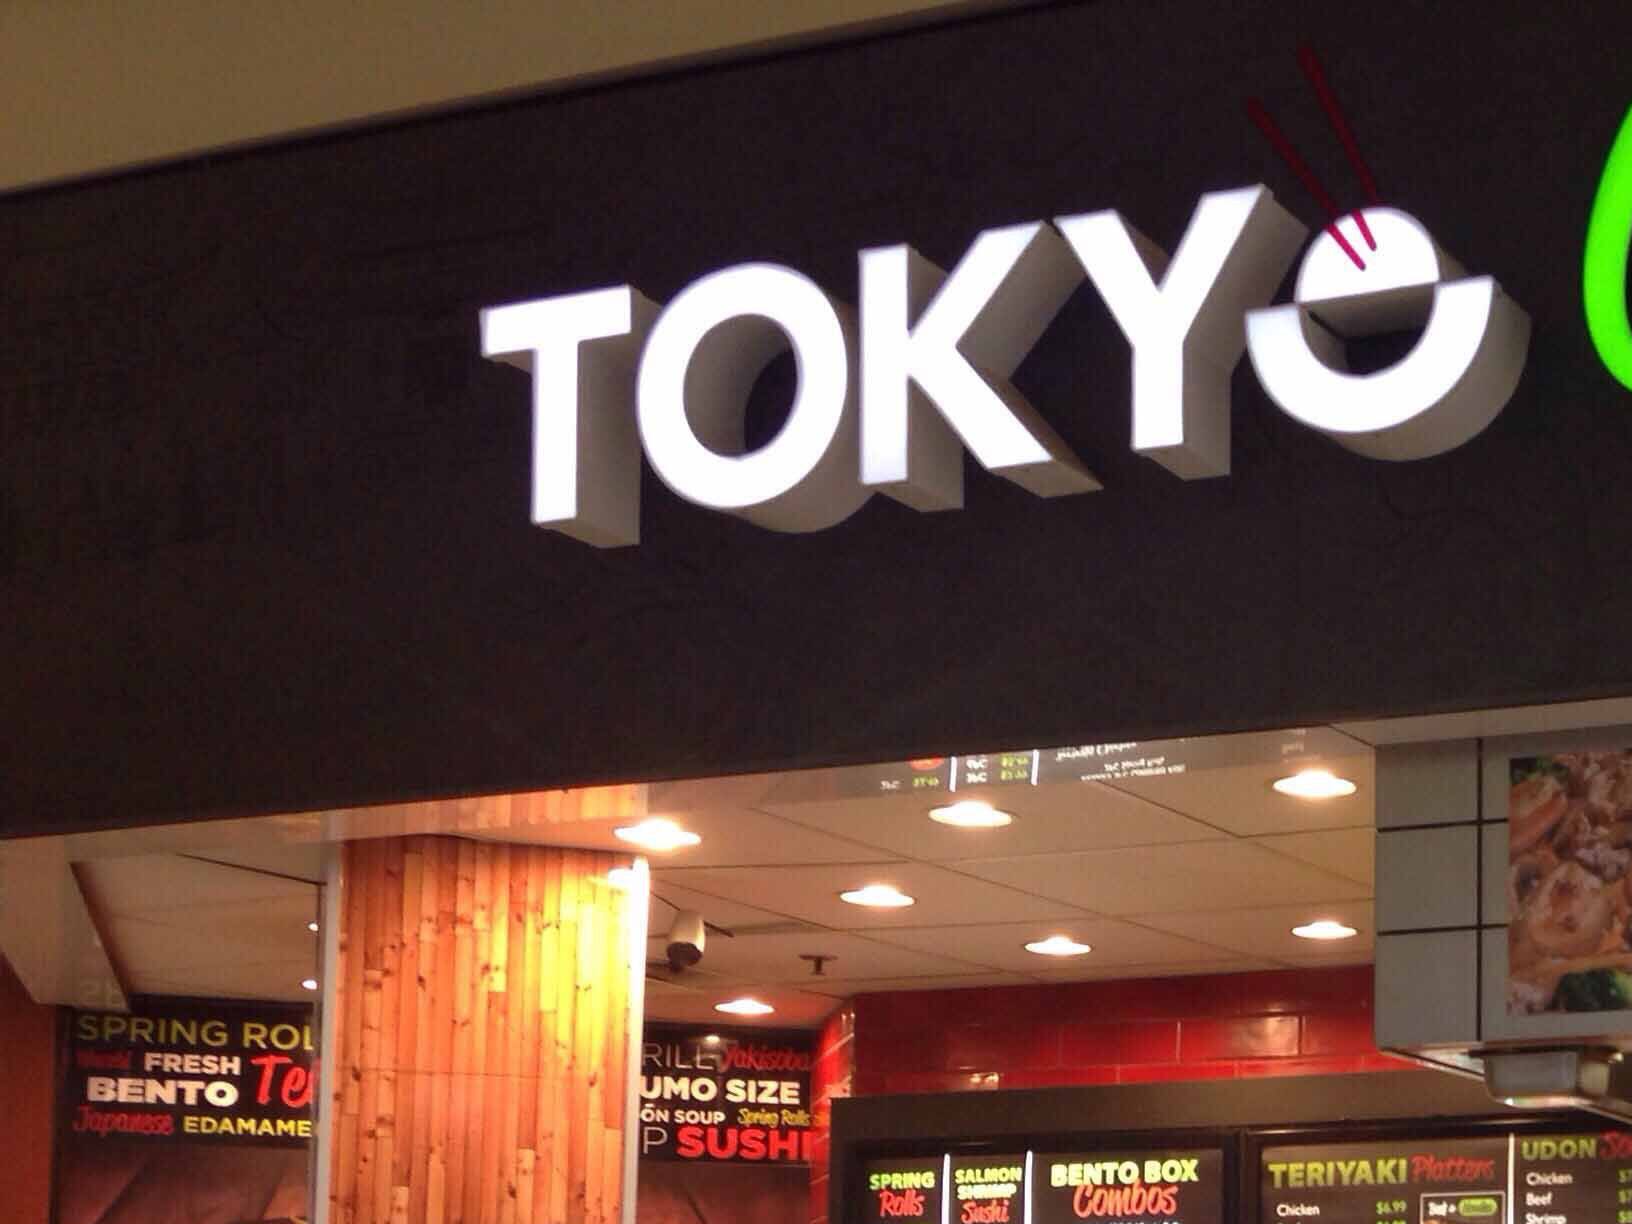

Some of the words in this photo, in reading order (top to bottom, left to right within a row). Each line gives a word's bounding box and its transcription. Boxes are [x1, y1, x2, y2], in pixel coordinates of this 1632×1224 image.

[480, 183, 1510, 540] TOKYO
[77, 1015, 229, 1047] SPRING
[144, 1052, 242, 1075] FRESH
[87, 1076, 240, 1107] BENTO
[725, 1079, 800, 1104] SIZE
[73, 1103, 175, 1137] Japanese
[184, 1116, 314, 1137] EDAMAME
[674, 1110, 725, 1125] SOUP
[738, 1108, 779, 1128] Spring
[644, 1127, 668, 1154] P
[676, 1126, 814, 1160] SUSHI
[1522, 1137, 1597, 1160] UDON
[870, 1171, 936, 1190] SPRING
[955, 1167, 1023, 1184] SALMON
[1050, 1160, 1140, 1188] BENTO
[1143, 1159, 1200, 1184] BOX
[1268, 1158, 1408, 1188] TERIYAKI
[1411, 1153, 1495, 1182] Platters
[1526, 1172, 1573, 1186] Chicken
[879, 1188, 924, 1217] Rolls
[1073, 1178, 1179, 1218] Combos
[1276, 1203, 1320, 1217] Chicken
[1376, 1200, 1407, 1215] $6.99
[1525, 1192, 1552, 1206] Beef
[961, 1199, 1010, 1224] Sushi
